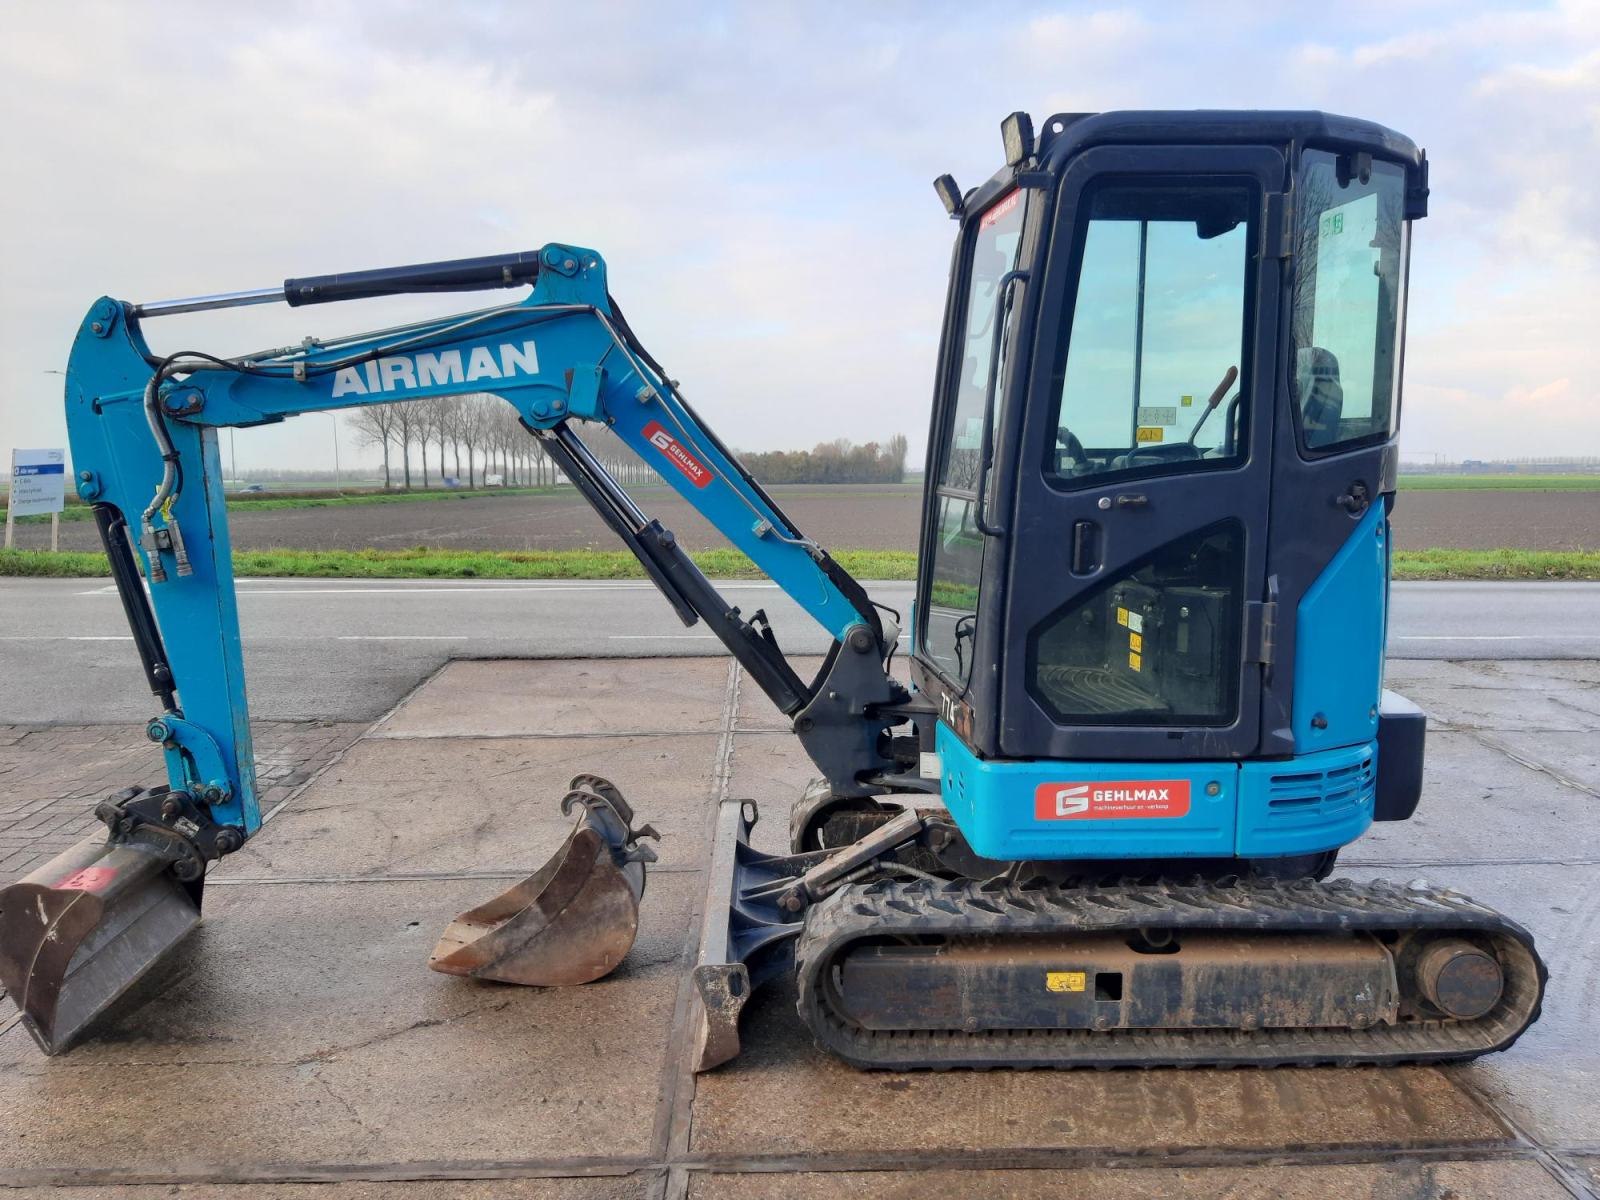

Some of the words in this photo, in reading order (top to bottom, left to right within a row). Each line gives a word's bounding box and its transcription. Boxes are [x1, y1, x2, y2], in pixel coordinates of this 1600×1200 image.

[331, 340, 539, 398] AIRMAN
[670, 445, 703, 477] GEHLMAX
[1093, 789, 1169, 801] GEHLMAX
